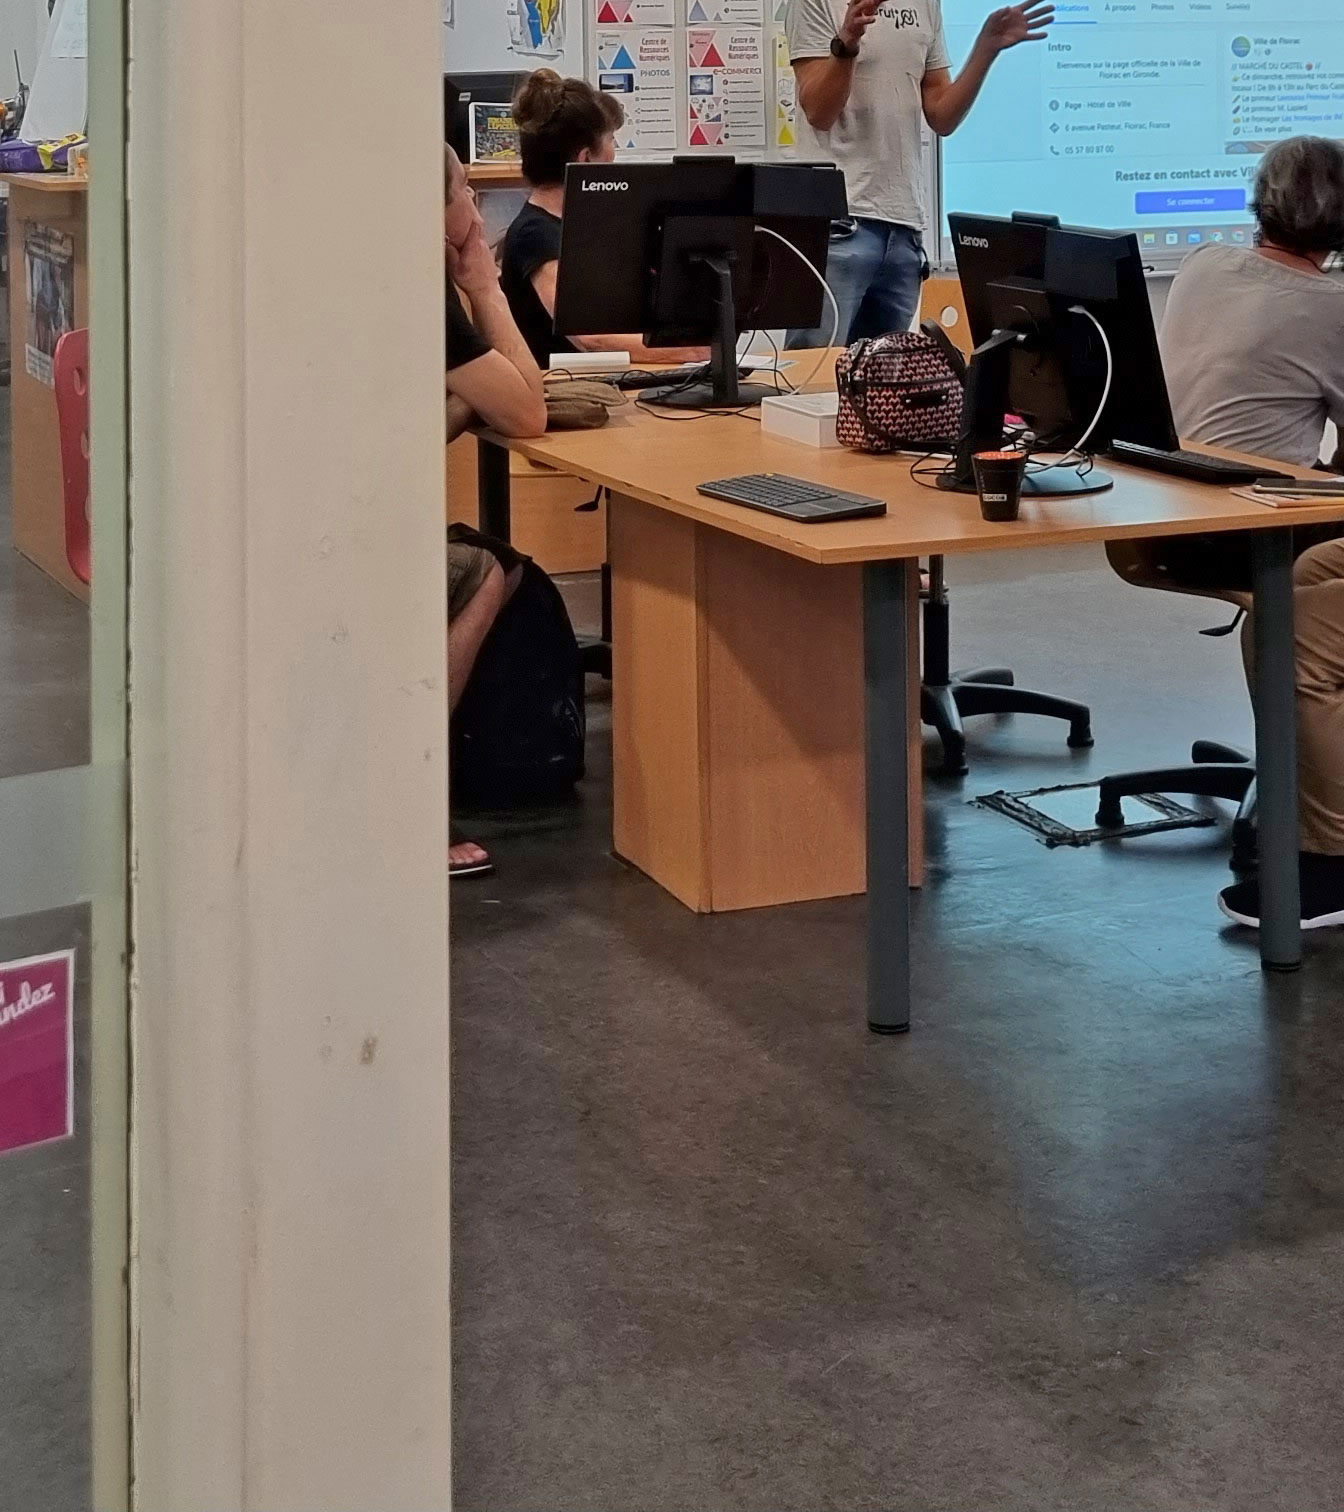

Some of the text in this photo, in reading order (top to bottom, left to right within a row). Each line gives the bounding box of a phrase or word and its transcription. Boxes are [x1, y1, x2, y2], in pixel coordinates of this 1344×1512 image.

[1048, 43, 1071, 52] Intro
[1115, 169, 1237, 182] Restez en contact avec
[582, 180, 628, 191] Lenovo
[958, 233, 989, 248] Lenovo
